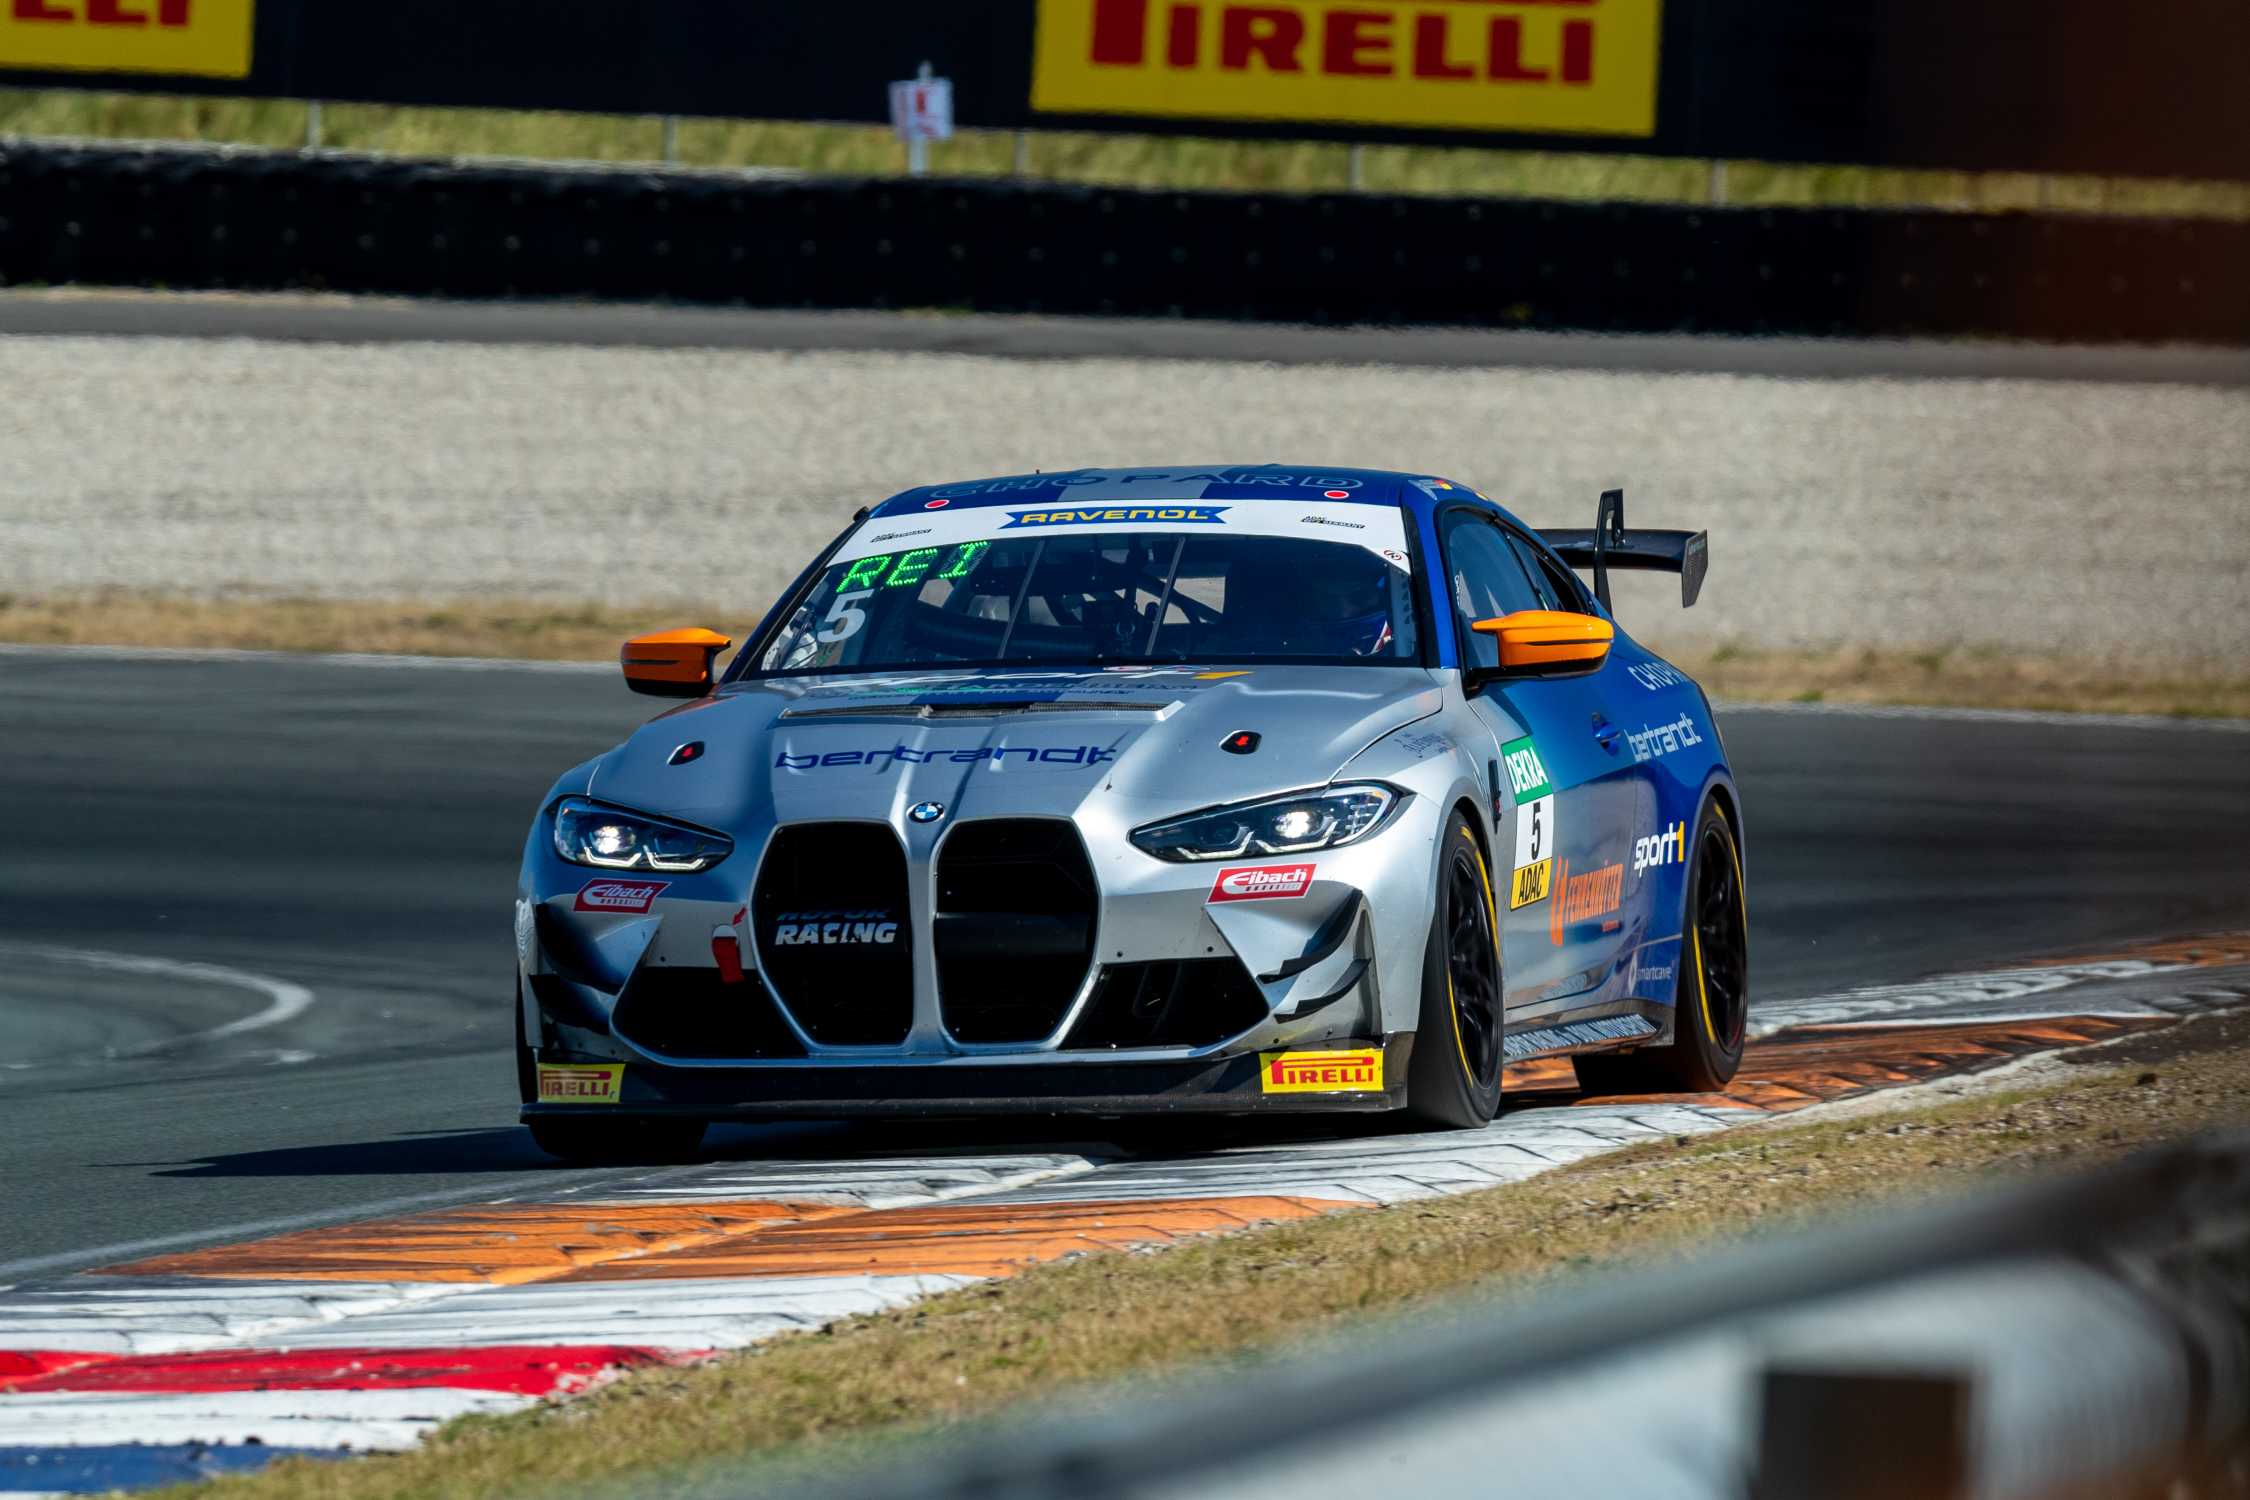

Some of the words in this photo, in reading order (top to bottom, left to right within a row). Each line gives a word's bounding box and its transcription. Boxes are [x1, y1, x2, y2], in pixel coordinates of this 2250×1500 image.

[1091, 0, 1595, 87] PIRELLI
[929, 472, 1365, 498] CHOPARD
[1020, 508, 1209, 524] RAVENOL
[836, 540, 992, 592] REI
[816, 588, 876, 644] 5
[1623, 711, 1703, 763] bertrandt
[774, 744, 1117, 770] bertrandt
[1504, 746, 1549, 795] DEKRA
[1531, 800, 1542, 861] 5
[1633, 821, 1685, 878] sport1
[583, 883, 656, 908] Eibach
[1222, 867, 1308, 894] Eibach
[1517, 863, 1544, 905] ADAC
[774, 922, 898, 945] RACING
[538, 1069, 612, 1097] PIRELLI
[1270, 1056, 1375, 1085] PIRELLI
